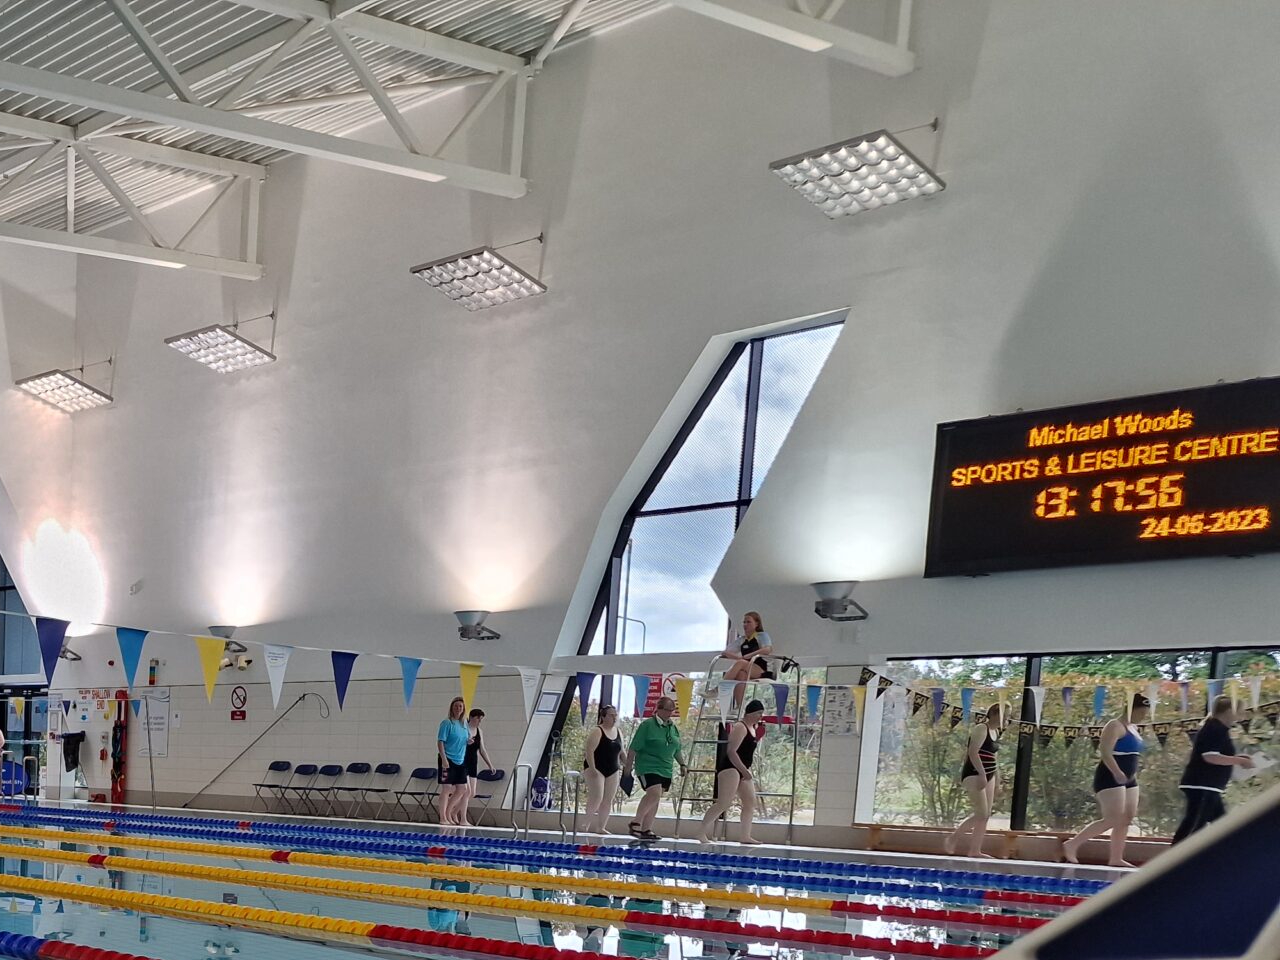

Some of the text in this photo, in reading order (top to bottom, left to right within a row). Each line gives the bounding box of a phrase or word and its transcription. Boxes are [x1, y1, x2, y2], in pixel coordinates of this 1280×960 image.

[1029, 407, 1194, 447] Michael Woods
[951, 429, 1279, 487] SPORTS & LEISURE CENTRE
[1139, 507, 1270, 538] 24-06-2023
[1021, 724, 1034, 734] 50
[1040, 727, 1056, 737] 50
[1064, 728, 1079, 737] 50
